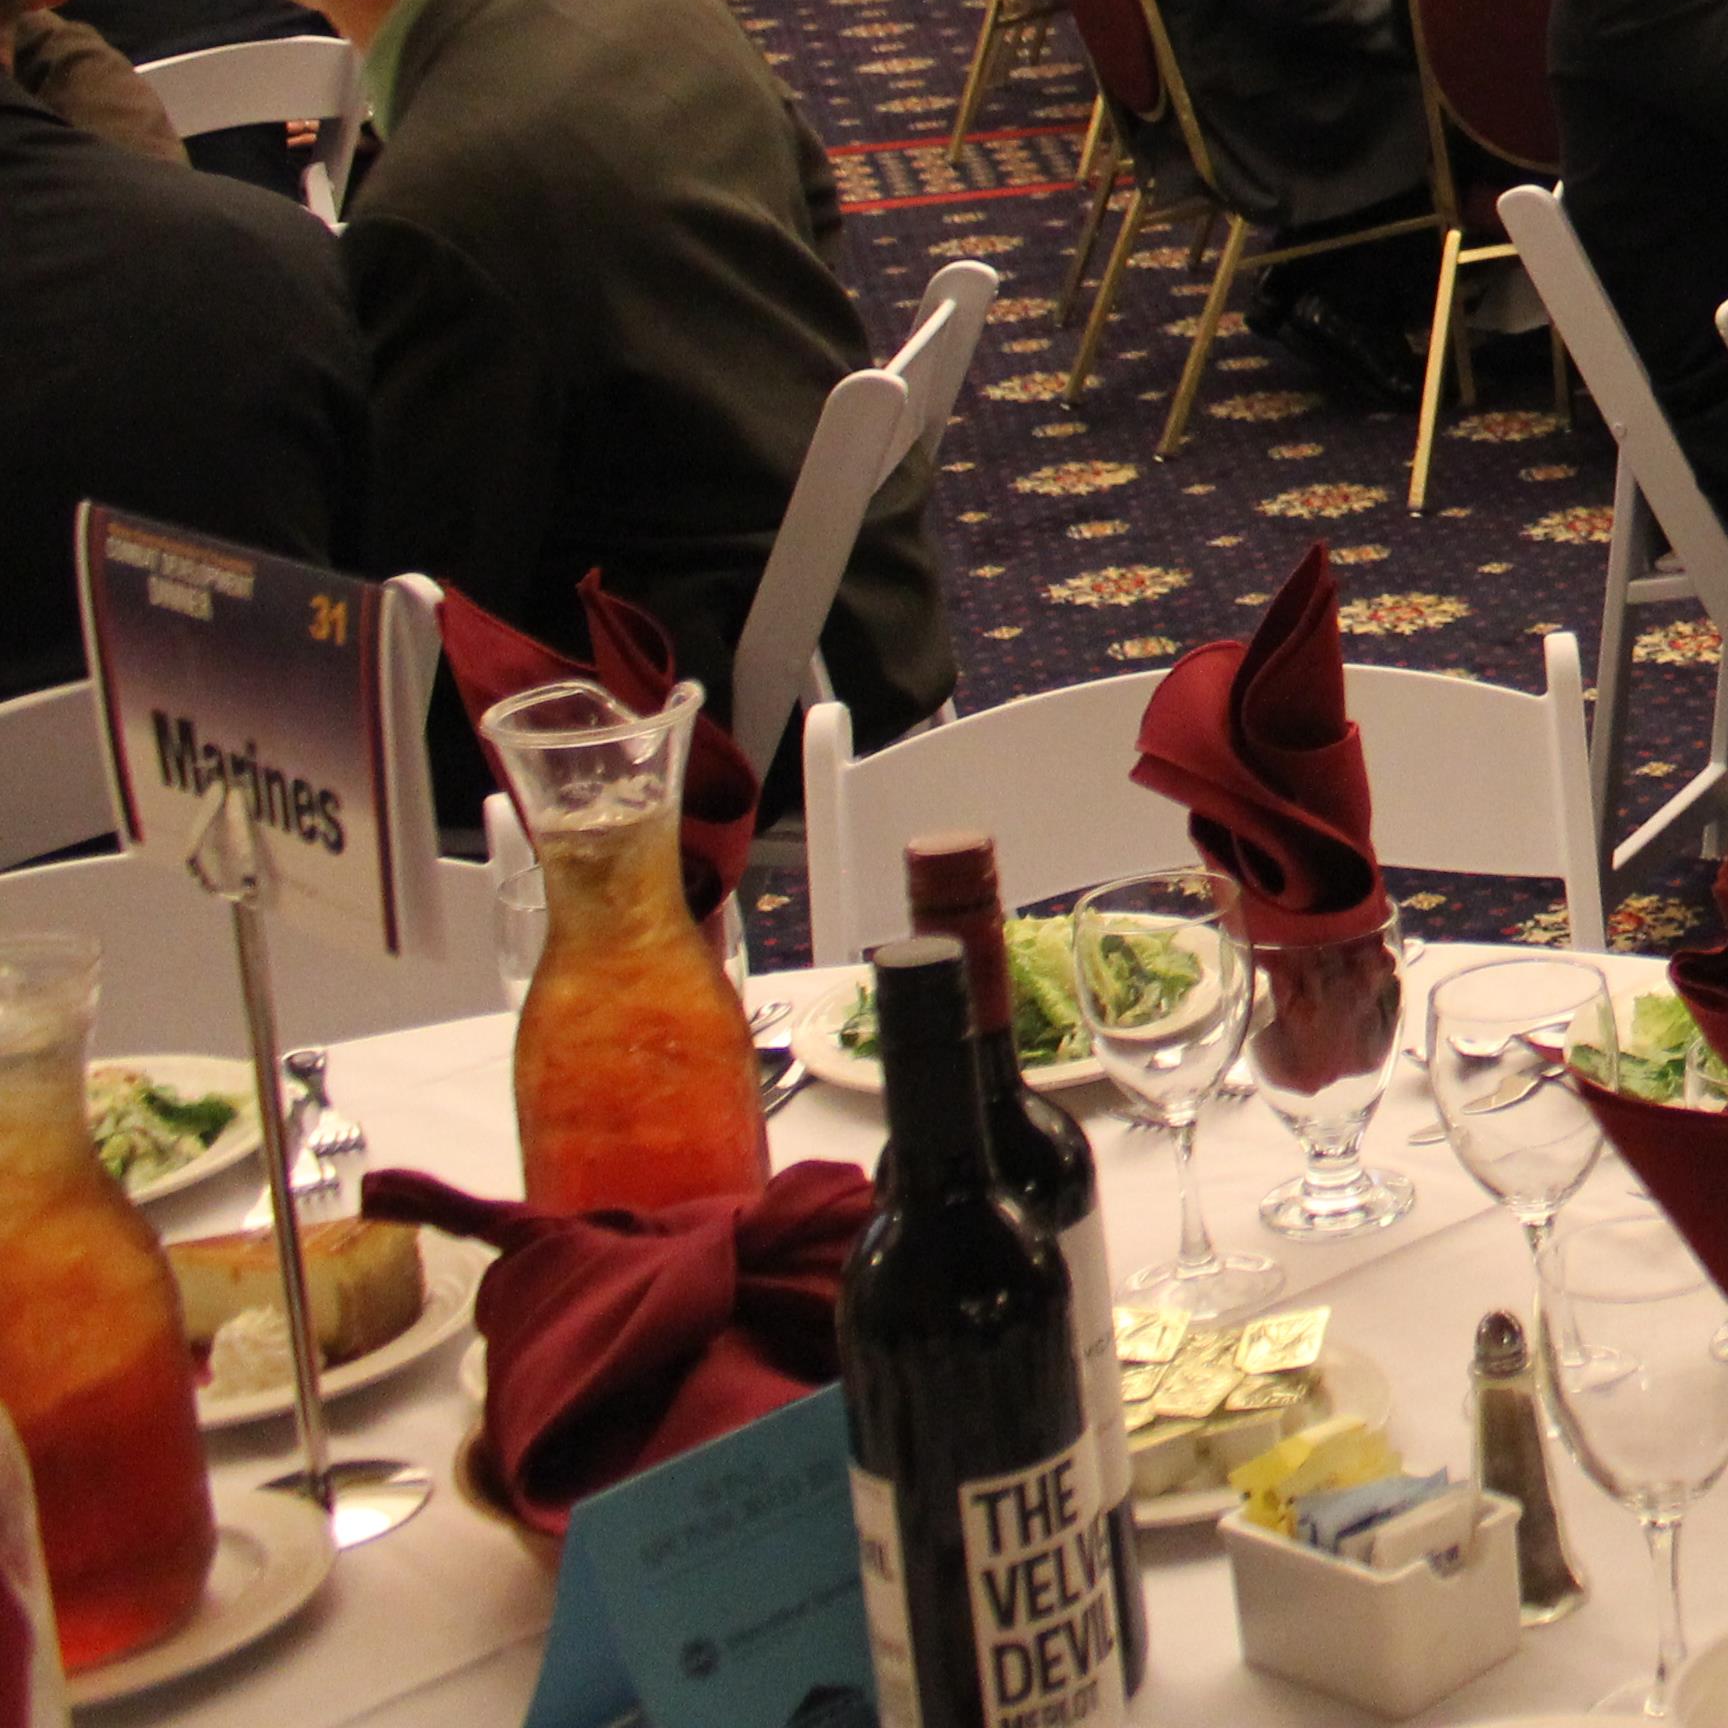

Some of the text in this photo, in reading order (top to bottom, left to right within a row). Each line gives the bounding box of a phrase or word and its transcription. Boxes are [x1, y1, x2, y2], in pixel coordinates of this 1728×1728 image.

[308, 594, 349, 647] 31
[151, 709, 346, 854] Marines
[971, 1458, 1079, 1557] THE
[991, 1593, 1113, 1708] DEVIL
